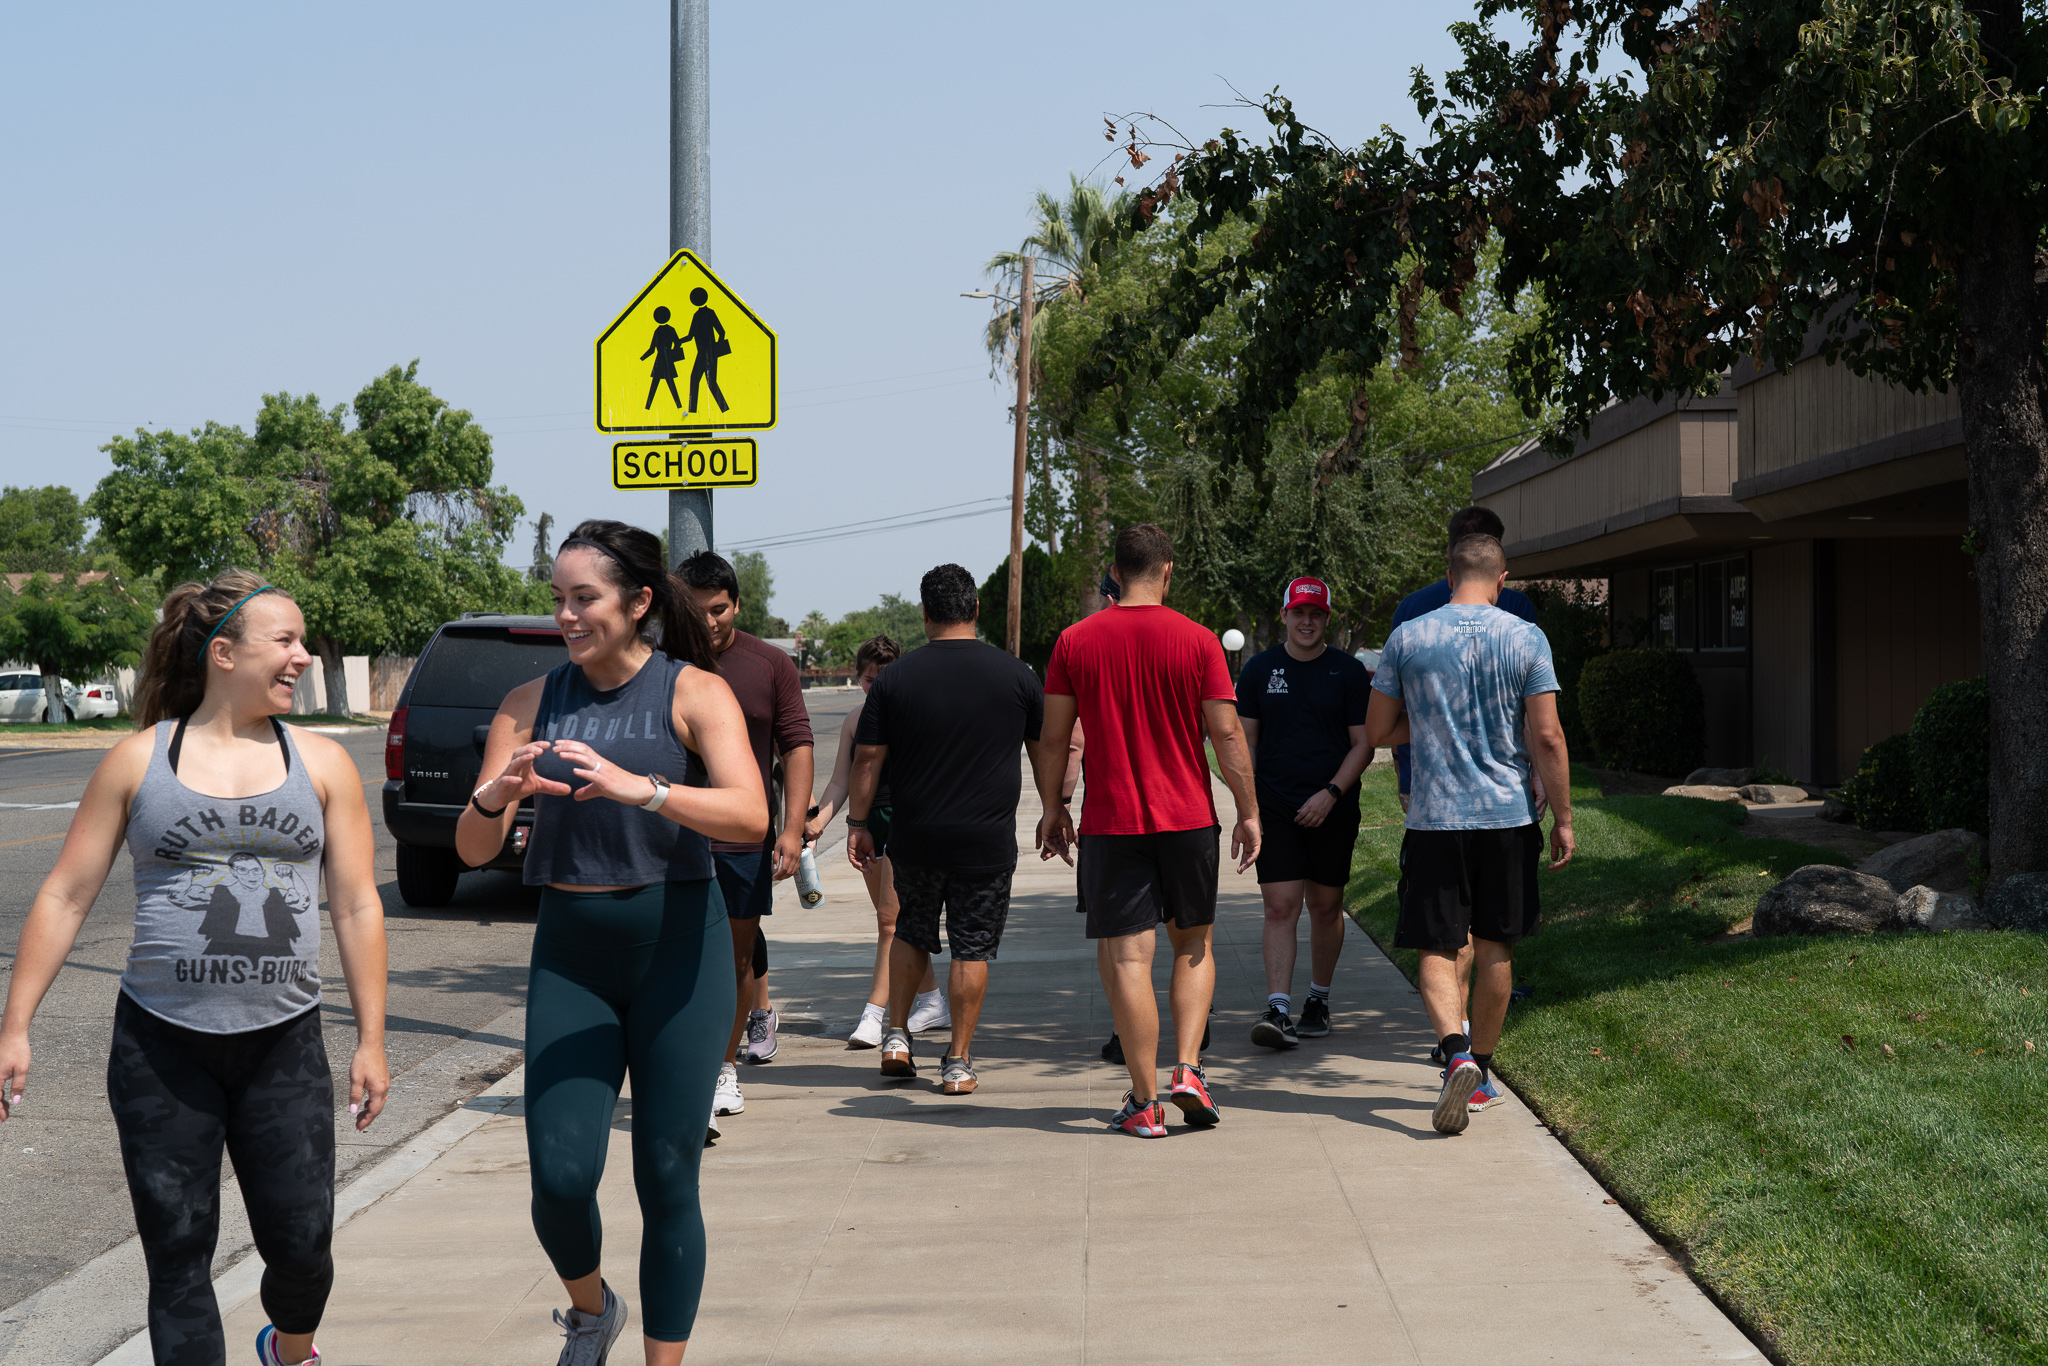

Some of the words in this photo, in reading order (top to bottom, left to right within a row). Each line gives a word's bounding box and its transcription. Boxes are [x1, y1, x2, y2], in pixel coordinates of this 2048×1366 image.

[623, 449, 749, 479] SCHOOL
[1453, 625, 1487, 634] NUTRITION
[545, 711, 657, 741] NOBULL
[410, 770, 449, 779] TAHOE
[154, 808, 226, 862] RUTH
[238, 804, 321, 857] BADER
